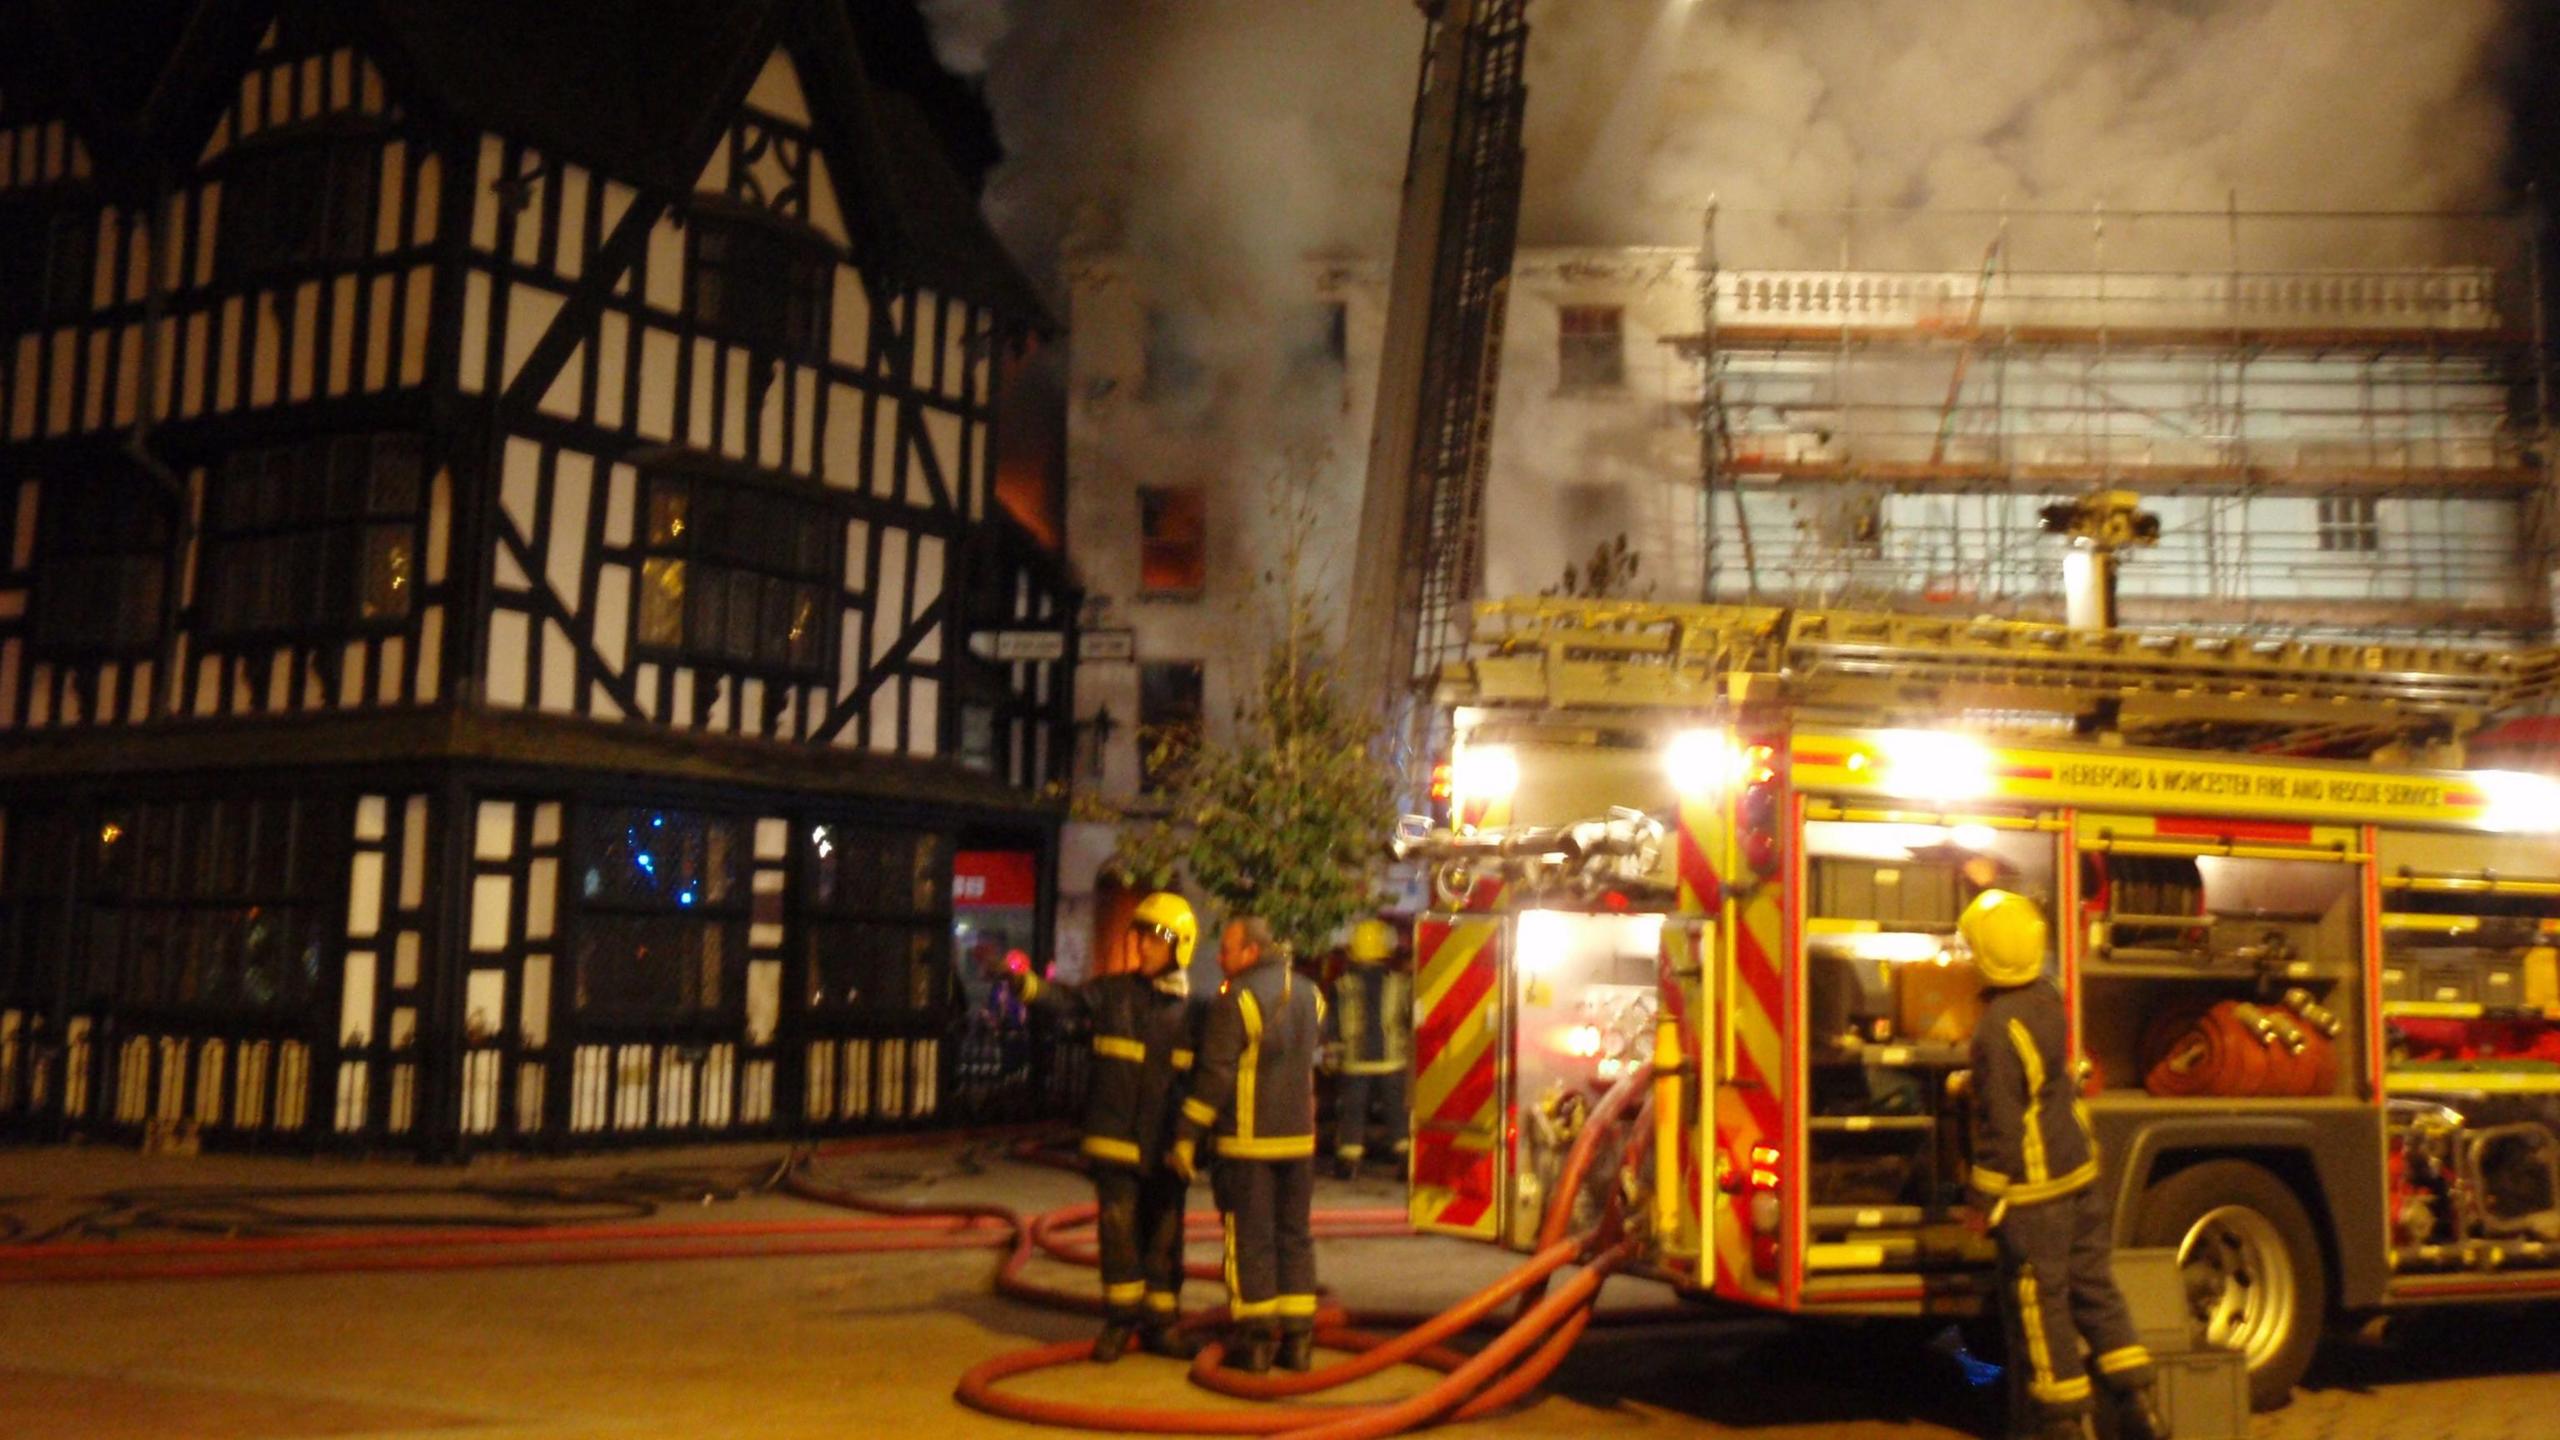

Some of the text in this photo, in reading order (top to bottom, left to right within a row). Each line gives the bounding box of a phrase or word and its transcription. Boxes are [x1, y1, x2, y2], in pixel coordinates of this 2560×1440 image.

[2256, 774, 2287, 798] FIRE
[2291, 776, 2324, 800] AND
[2329, 778, 2382, 803] RESCUE
